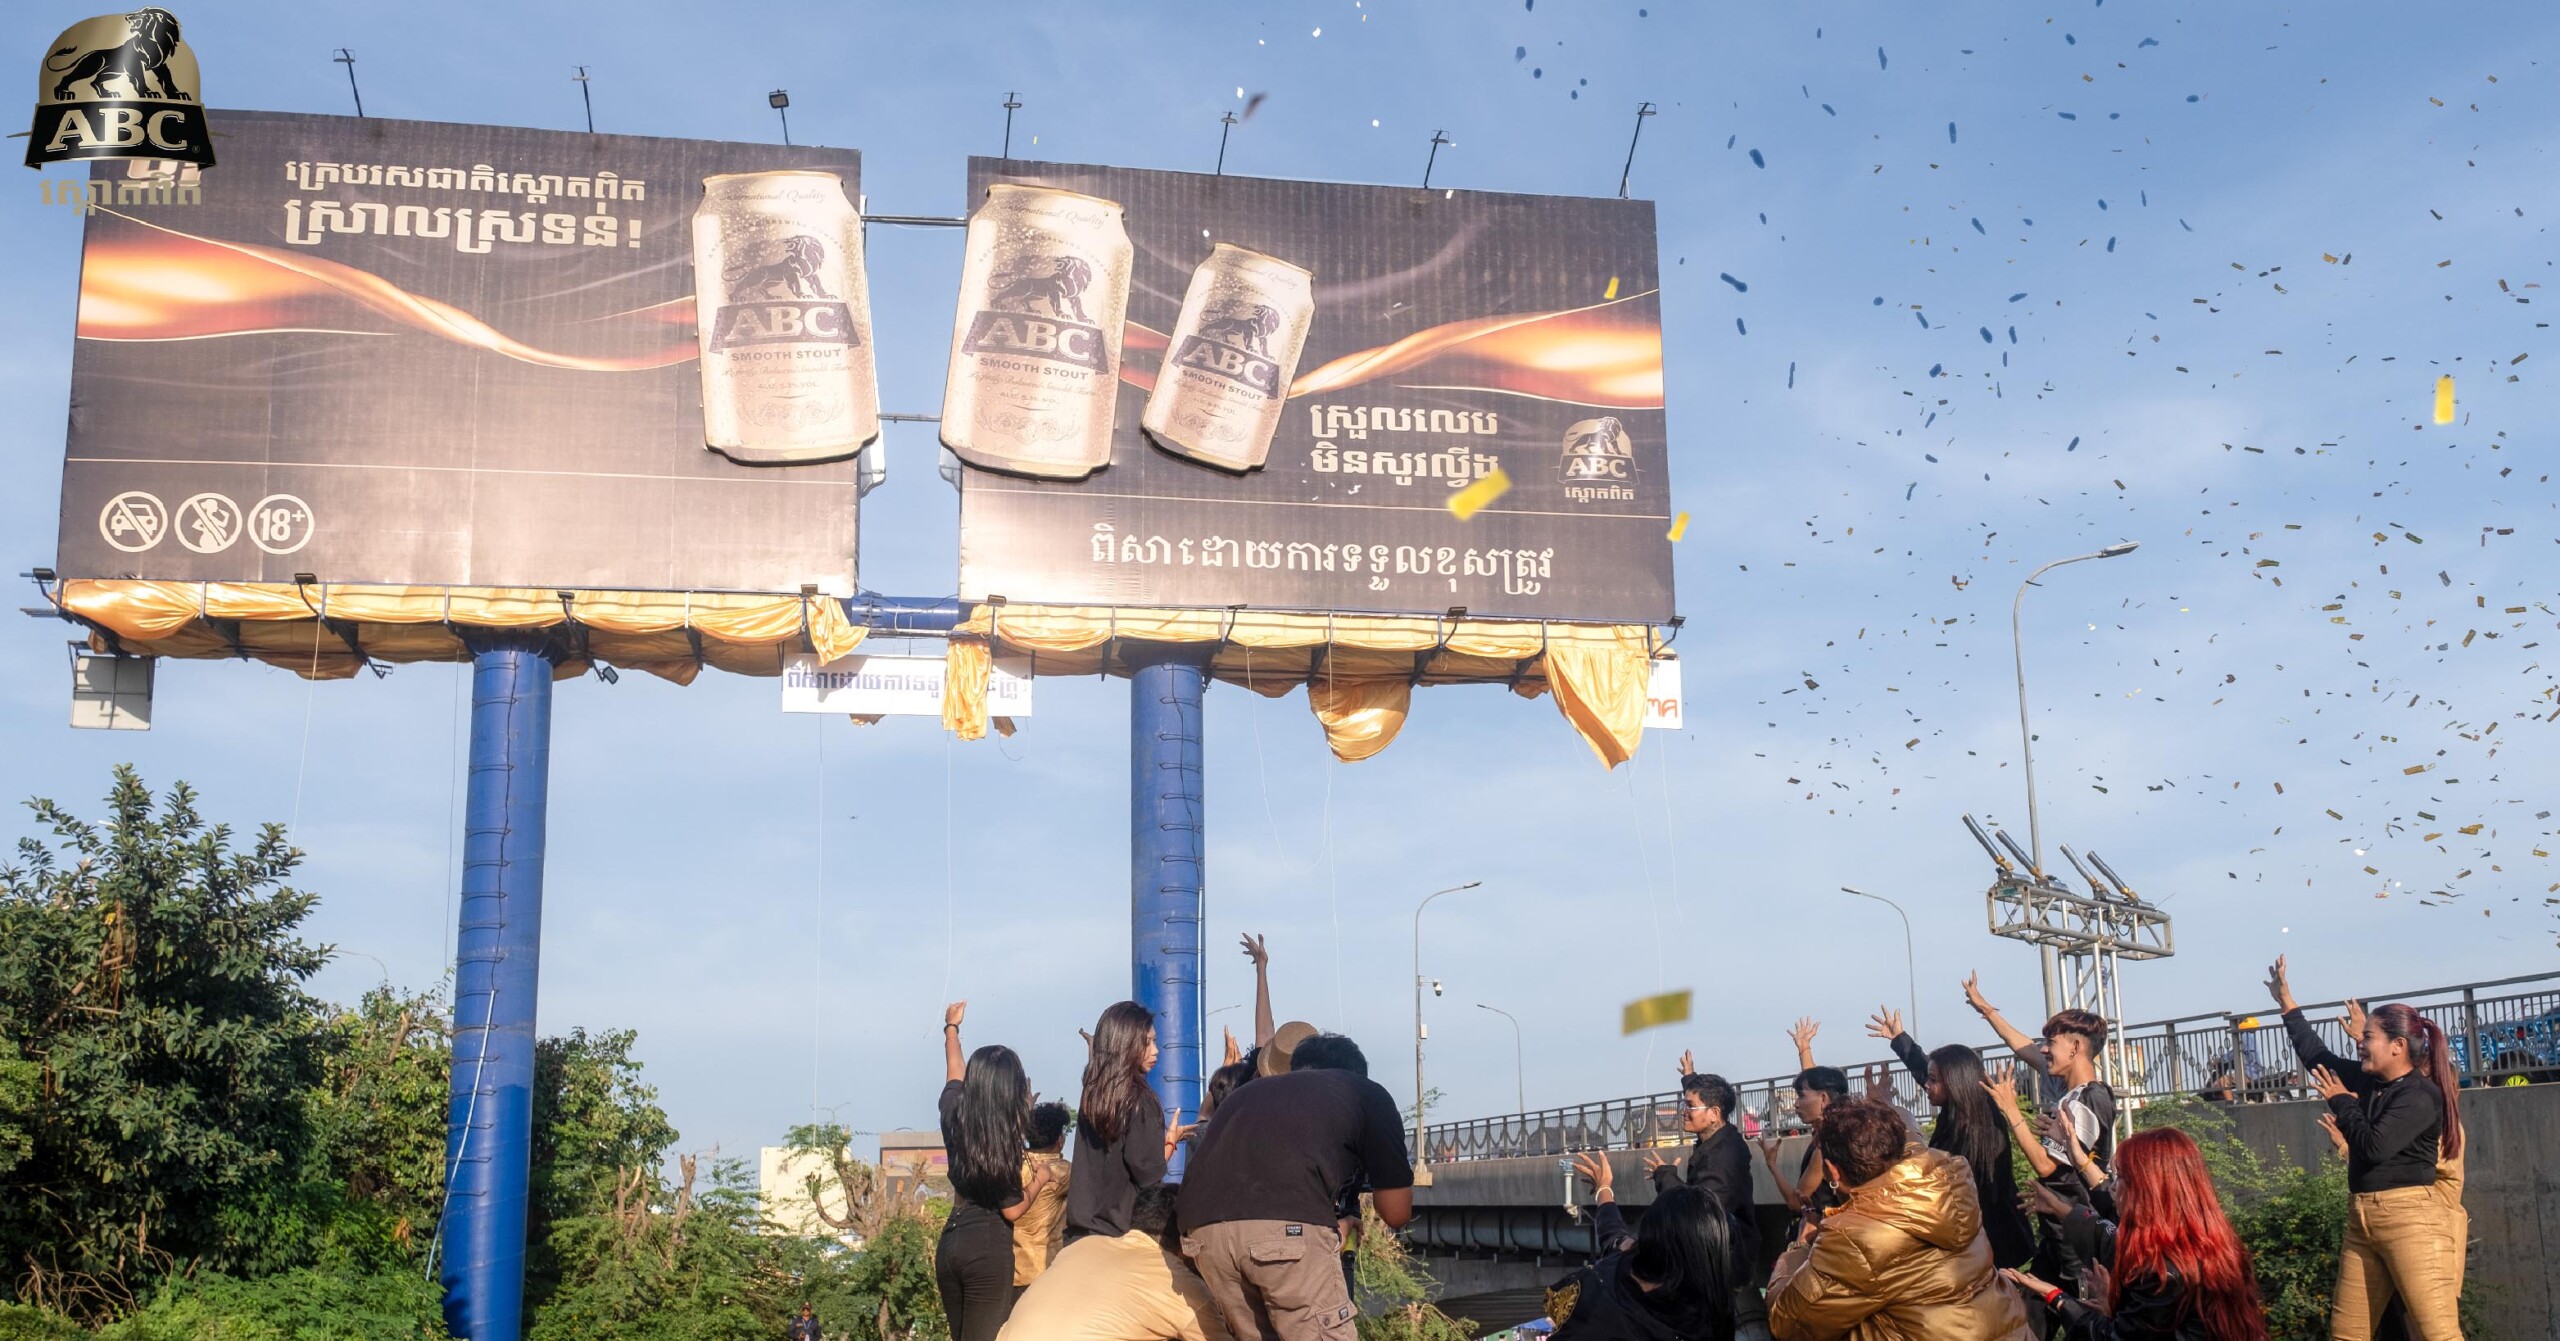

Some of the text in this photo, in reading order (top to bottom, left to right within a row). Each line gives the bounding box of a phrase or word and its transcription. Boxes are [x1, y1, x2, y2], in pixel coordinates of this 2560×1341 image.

[724, 305, 839, 342] ABC
[976, 317, 1090, 361] ABC
[731, 348, 841, 362] SMOOTH STOUT
[979, 357, 1089, 381] SMOOTH STOUT
[1183, 342, 1270, 387] ABC
[1182, 369, 1226, 389] SMOOTH
[1227, 384, 1264, 401] STOUT
[1565, 457, 1628, 479] ABC
[260, 508, 305, 542] 18+
